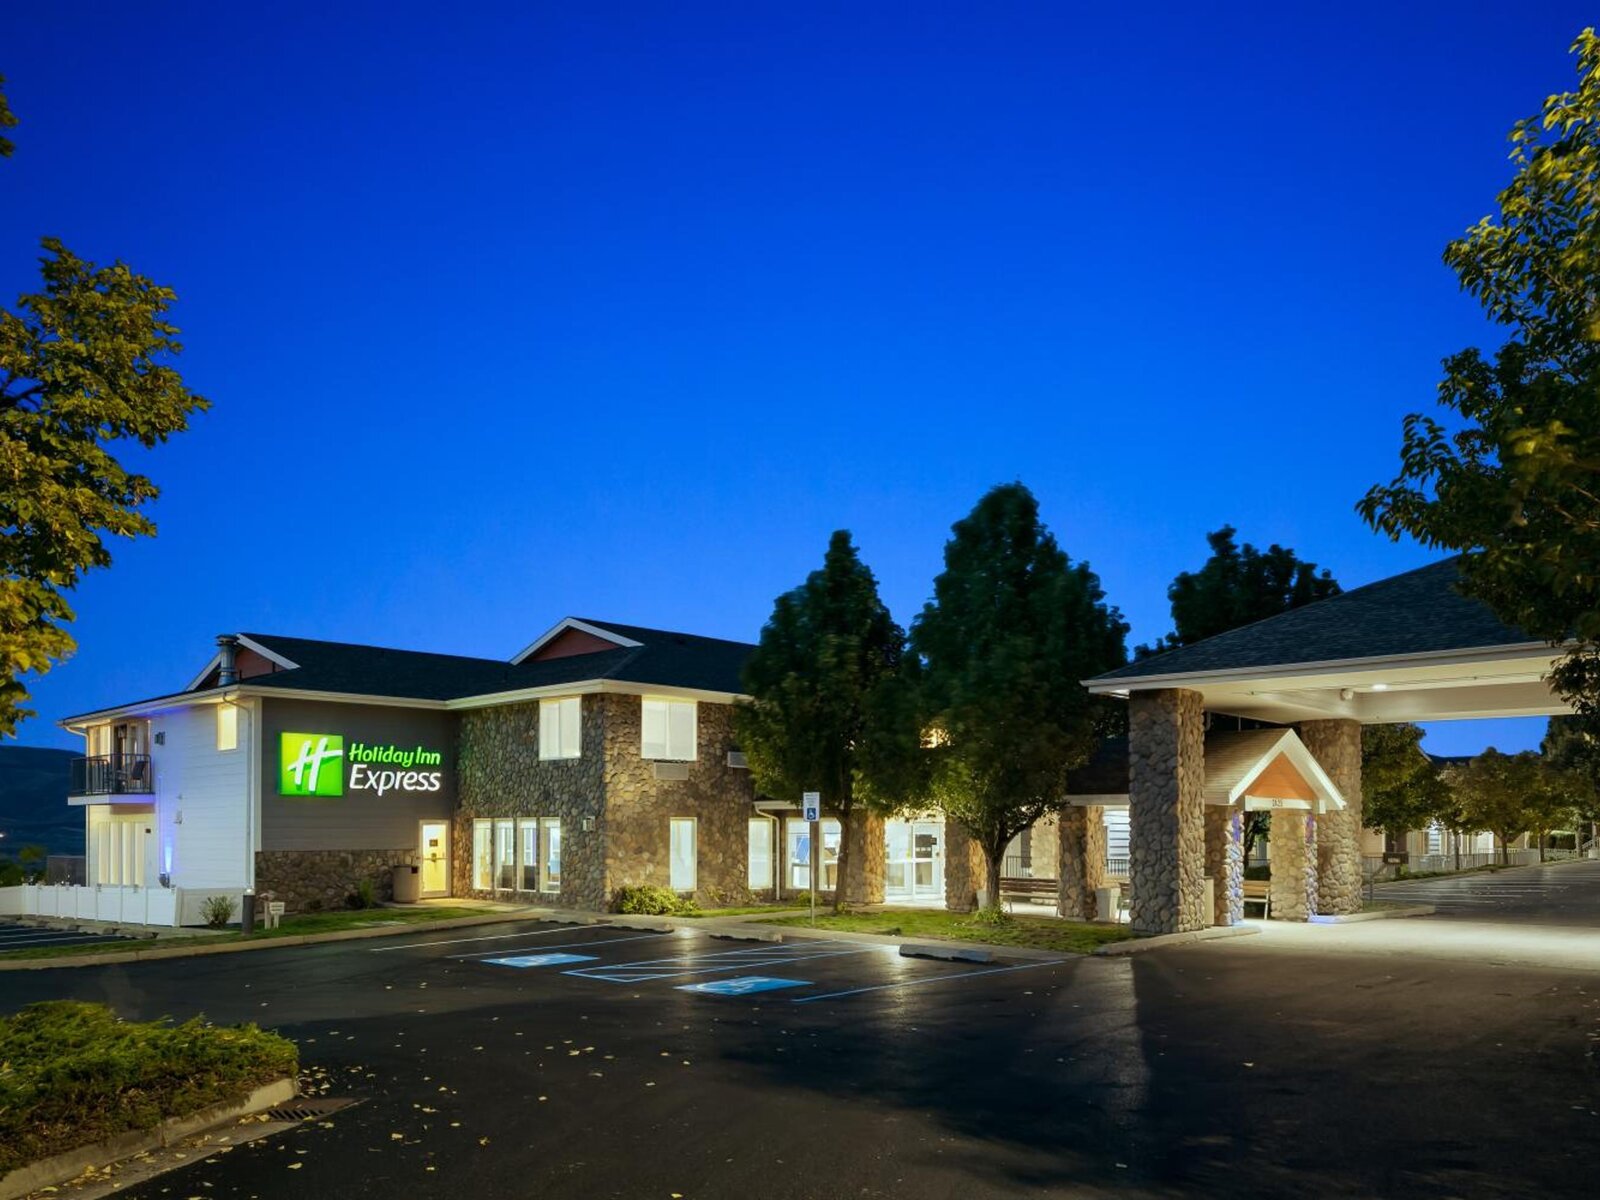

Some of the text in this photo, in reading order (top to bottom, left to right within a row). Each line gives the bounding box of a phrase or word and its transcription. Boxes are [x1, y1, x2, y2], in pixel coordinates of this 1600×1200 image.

[349, 743, 441, 768] Holiday Inn
[349, 764, 441, 796] Express
